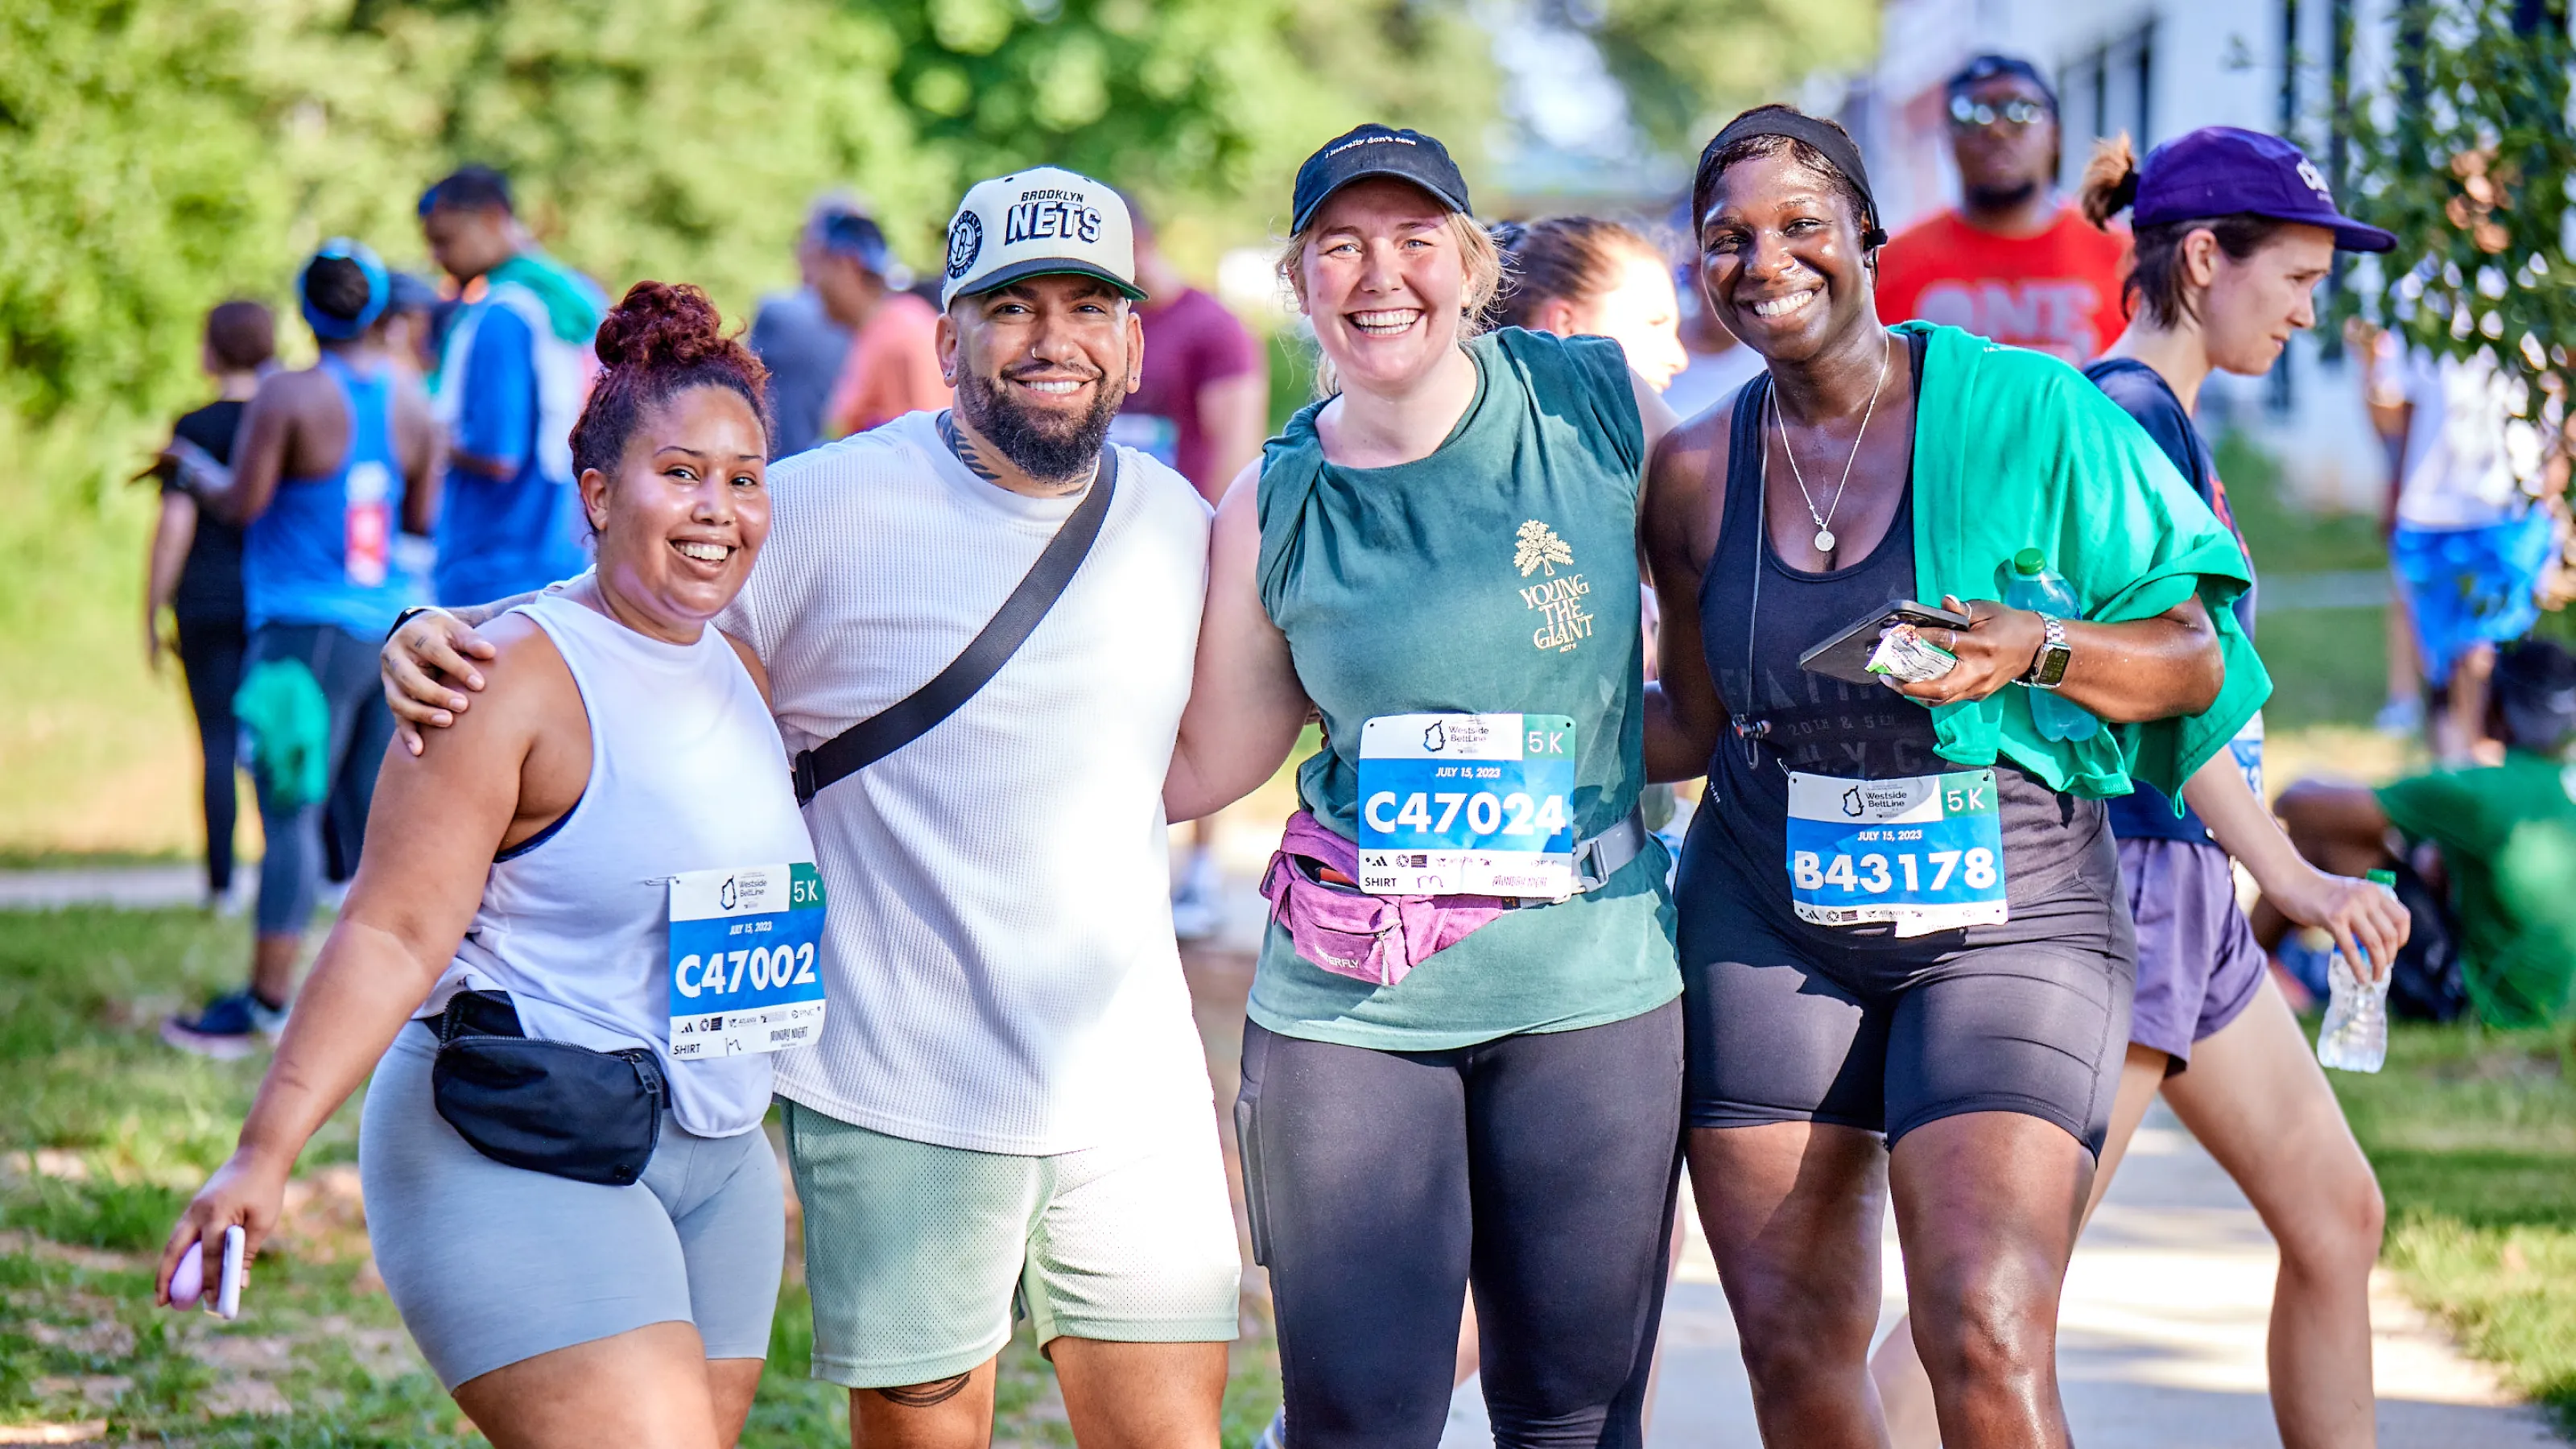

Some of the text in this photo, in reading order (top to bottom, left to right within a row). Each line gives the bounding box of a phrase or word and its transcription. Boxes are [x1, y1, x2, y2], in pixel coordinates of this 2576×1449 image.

[1021, 189, 1084, 202] BROOKLYN
[1005, 201, 1101, 244] NETS
[1518, 574, 1590, 609] YOUNG
[1538, 597, 1584, 625] THE
[1534, 614, 1594, 650] GIANT
[1436, 767, 1501, 779] JULY 15, 2023
[1865, 790, 1908, 799] Westside
[1868, 799, 1905, 808] BeltLine
[1364, 791, 1567, 836] C47024
[1857, 829, 1923, 842] JULY 15, 2023
[1794, 847, 1997, 894] B43178
[738, 878, 768, 889] Westside
[1364, 877, 1397, 888] SHIRT
[739, 887, 766, 898] BeltLine
[729, 921, 774, 935] JULY 15, 2023
[675, 942, 816, 998] C47002
[673, 1043, 700, 1055] SHIRT
